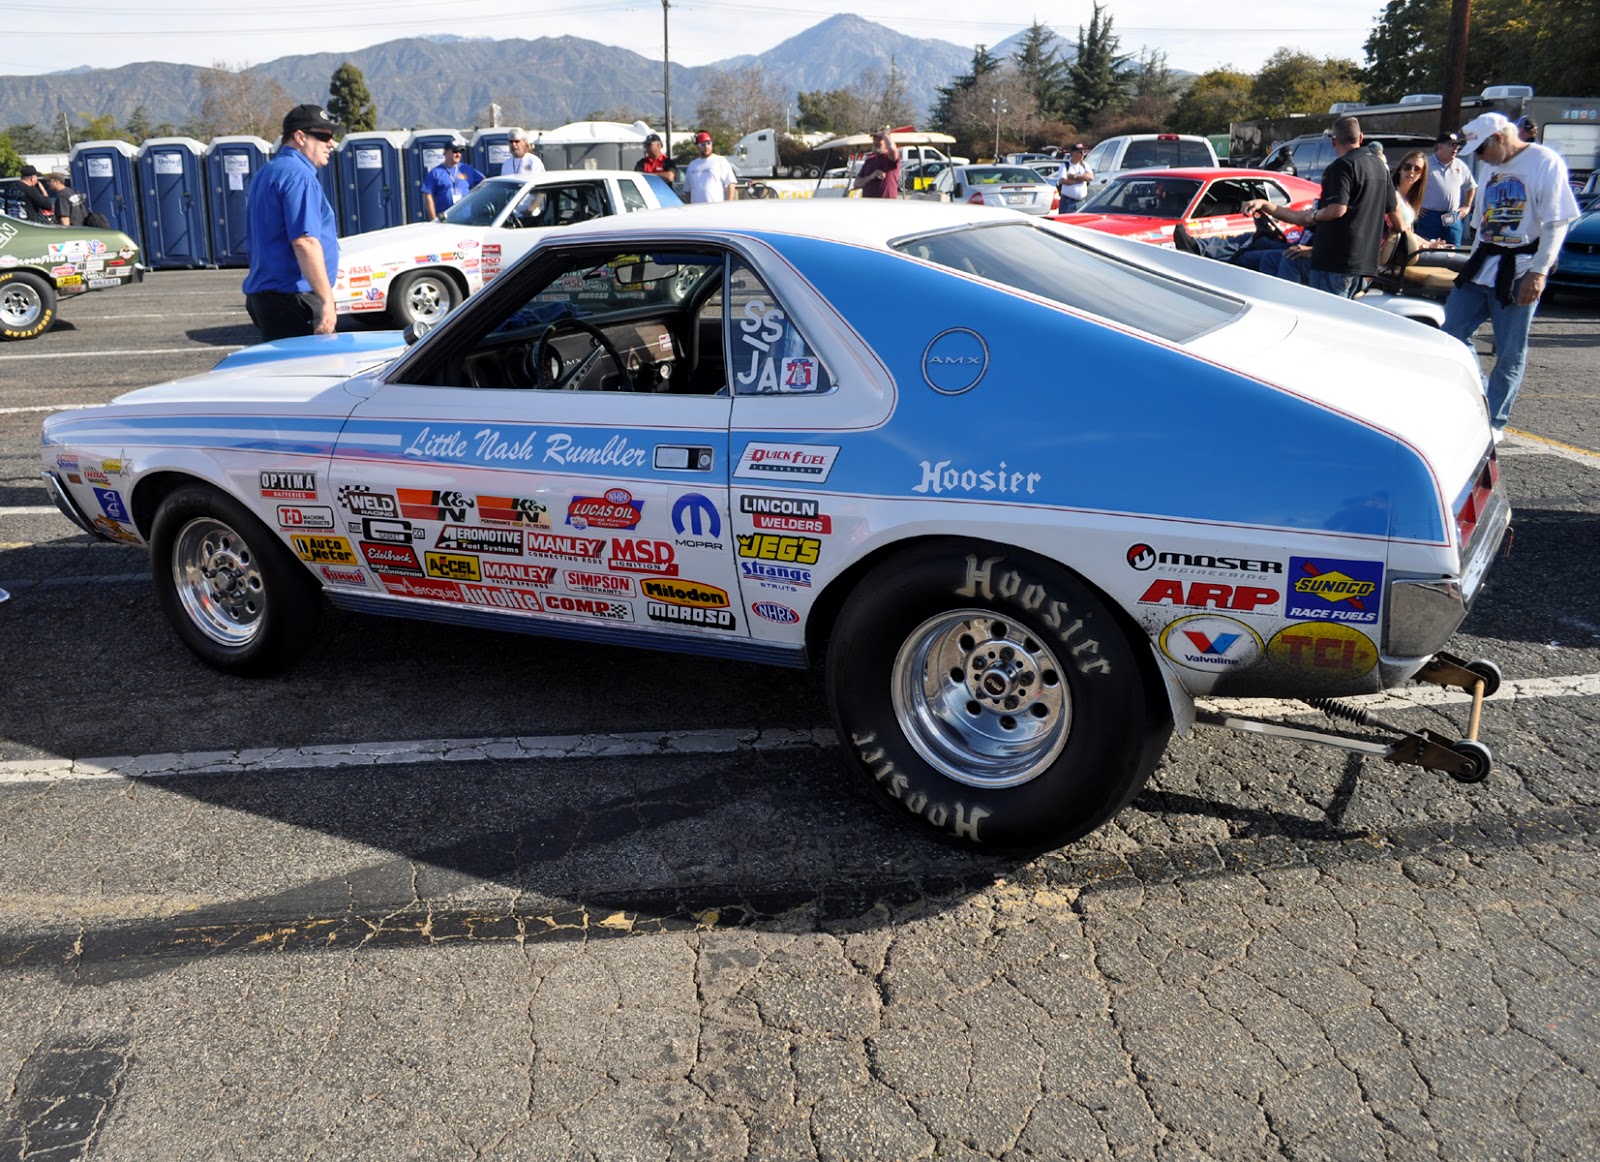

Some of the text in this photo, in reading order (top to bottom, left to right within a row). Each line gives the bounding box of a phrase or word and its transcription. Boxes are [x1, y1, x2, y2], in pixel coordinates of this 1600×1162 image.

[564, 280, 584, 288] MSD
[928, 355, 982, 364] AMX
[404, 426, 647, 467] Little Nash Rumbler
[261, 473, 315, 490] OPTIMA
[912, 460, 1042, 494] Hoosier
[348, 495, 394, 511] WELD
[608, 491, 628, 502] NHRA
[573, 504, 633, 519] LUCAS OIL
[743, 498, 815, 516] LINCOLN
[760, 516, 823, 531] WELDERS
[310, 539, 342, 549] Auto
[483, 544, 519, 553] Systems
[528, 533, 598, 556] MANLEY
[612, 538, 675, 563] MSD
[675, 539, 723, 550] MOPAR
[311, 549, 352, 561] Meter
[368, 548, 412, 563] Edelbrock
[528, 552, 578, 562] CONNECTING
[1158, 552, 1283, 574] MOSER
[378, 568, 422, 577] ACQUISITION
[430, 556, 476, 576] ACCEL
[483, 561, 550, 582] MANLEY
[615, 561, 661, 570] IGNITION
[741, 560, 811, 581] Strange
[1158, 566, 1268, 581] ENGINEERING
[402, 577, 460, 600] Aeroquip
[516, 581, 549, 589] SPRINGS
[568, 572, 630, 590] SIMPSON
[760, 582, 797, 592] STRUTS
[1296, 578, 1375, 596] SUNOCO
[459, 584, 540, 611] Autolite
[581, 586, 622, 595] RESTRAINTS
[645, 582, 725, 604] Milodon
[1139, 578, 1280, 611] ARP
[545, 596, 610, 613] COMP
[592, 611, 624, 619] CAMS
[648, 602, 732, 627] MOROSO
[758, 605, 793, 621] NHRA
[954, 553, 1111, 676] Hoosier
[1289, 607, 1376, 622] RACE FUELS
[1184, 654, 1239, 665] Valvoline
[1281, 634, 1356, 669] TCI
